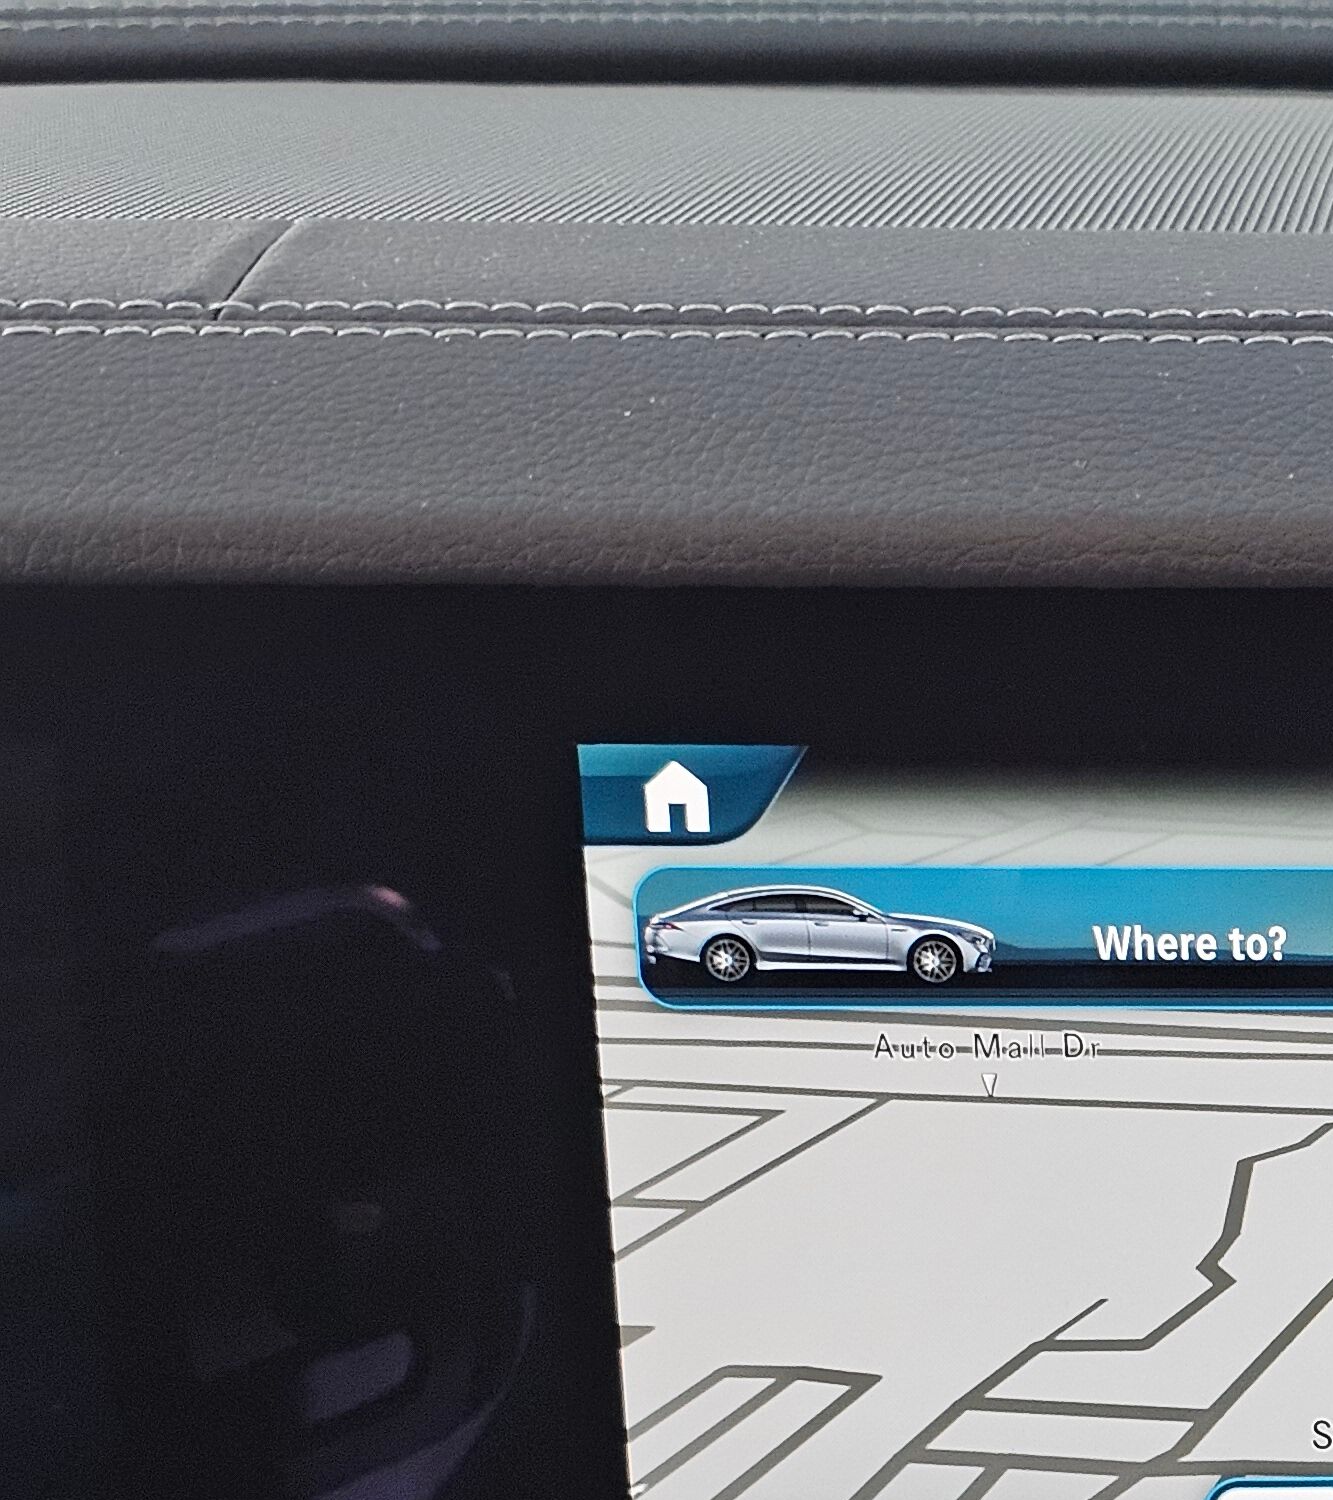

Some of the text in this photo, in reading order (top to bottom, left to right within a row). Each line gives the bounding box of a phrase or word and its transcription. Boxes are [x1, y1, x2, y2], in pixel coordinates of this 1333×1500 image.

[1092, 925, 1286, 960] Where to?
[875, 1033, 1099, 1058] Auto Mall Dr
[1313, 1420, 1332, 1449] S
